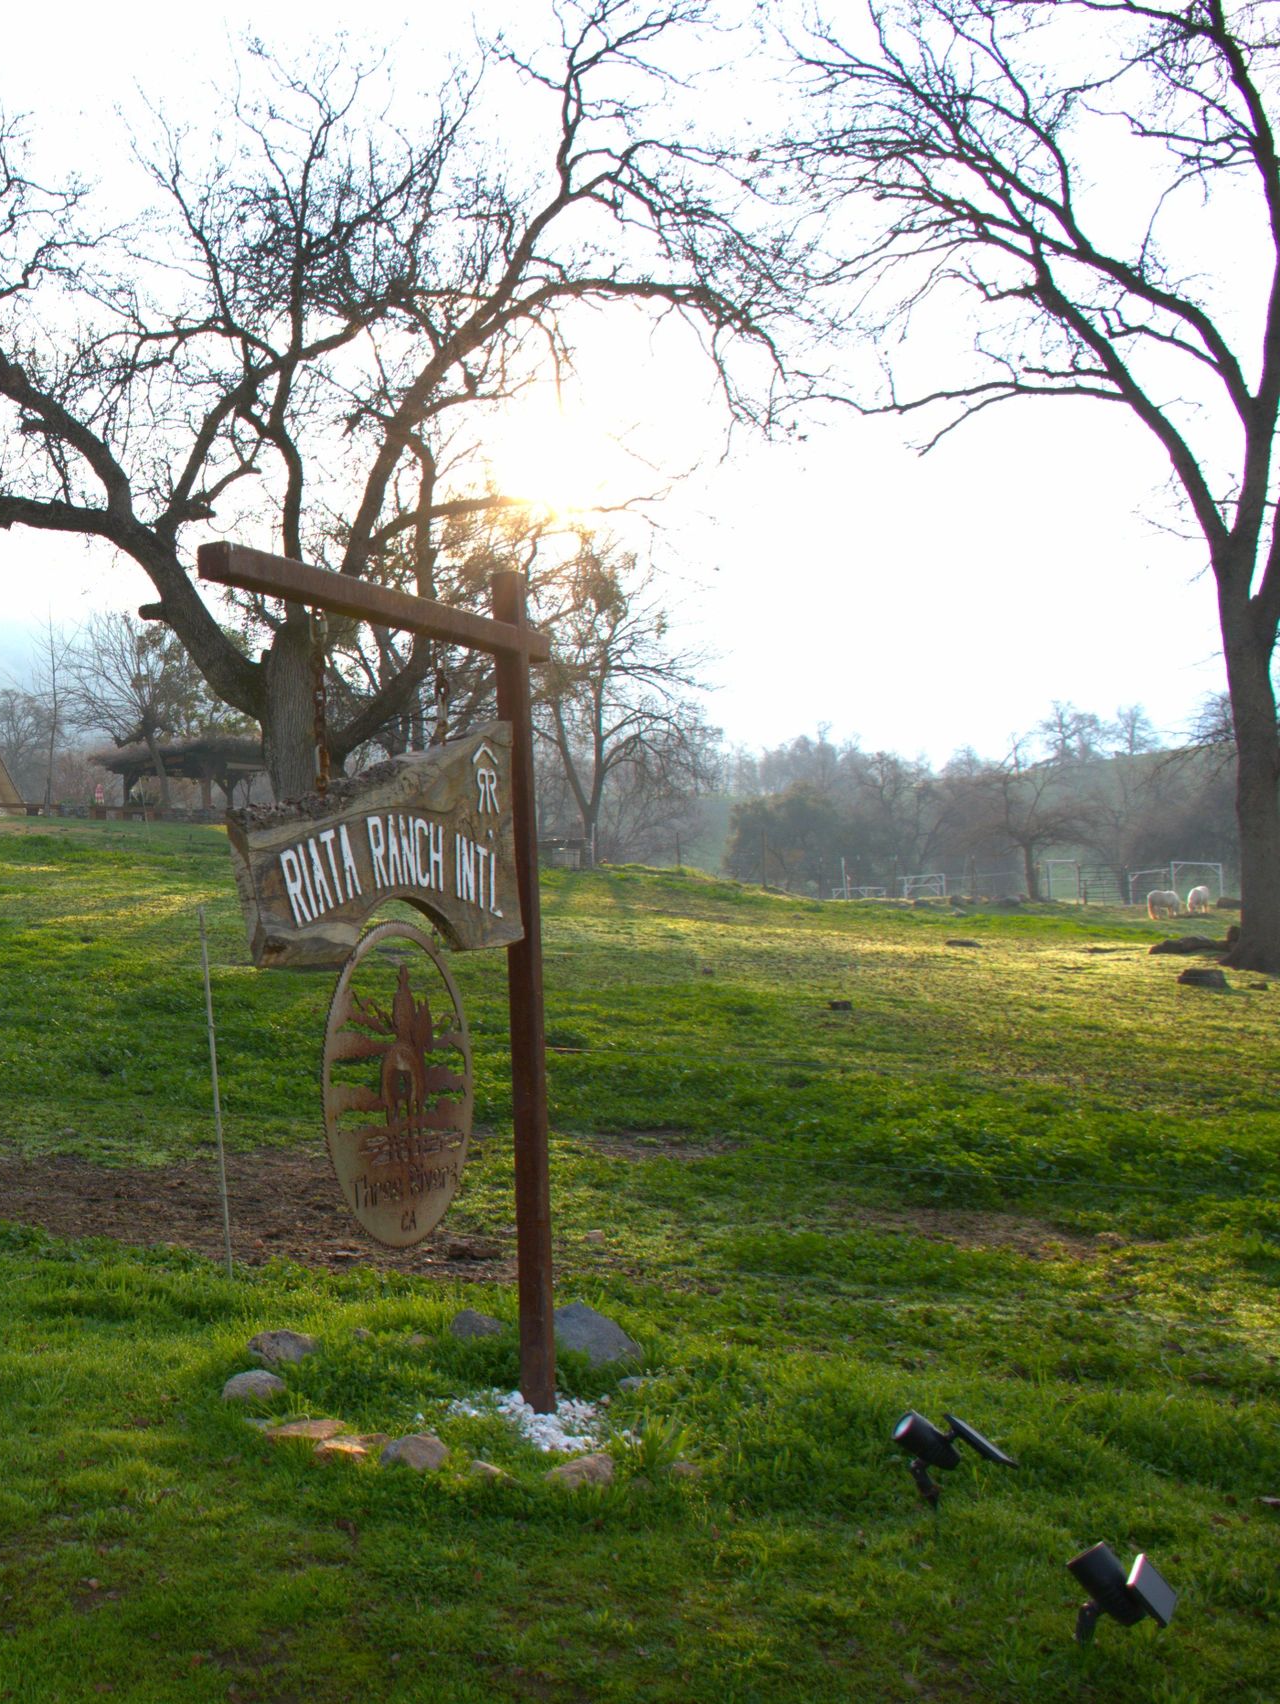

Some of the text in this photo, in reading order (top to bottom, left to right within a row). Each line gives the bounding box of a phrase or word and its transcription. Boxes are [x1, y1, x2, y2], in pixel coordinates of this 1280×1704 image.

[279, 824, 362, 928] RIATA
[366, 814, 444, 893] RANCH
[400, 1209, 418, 1232] CA
